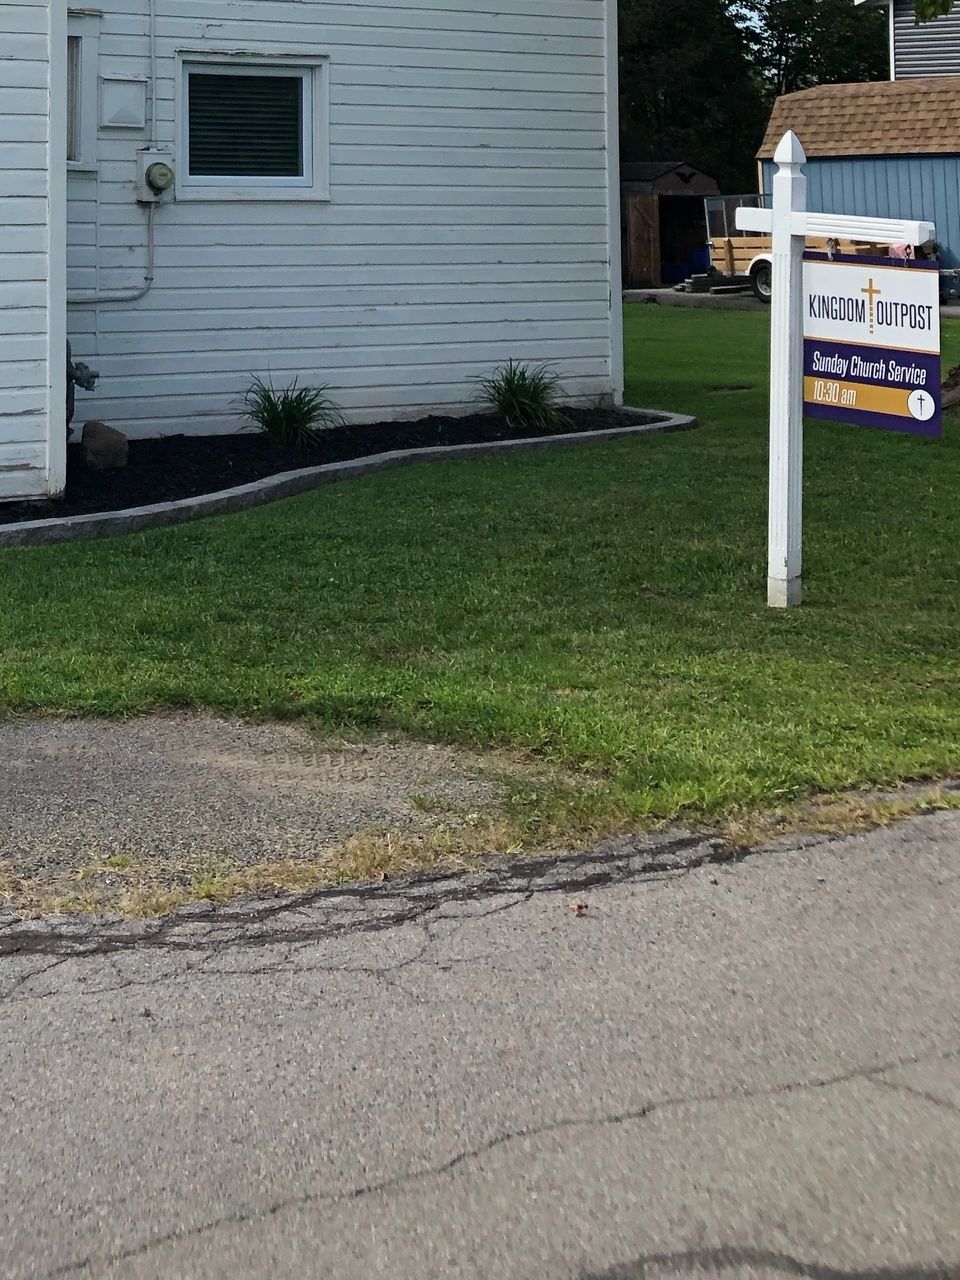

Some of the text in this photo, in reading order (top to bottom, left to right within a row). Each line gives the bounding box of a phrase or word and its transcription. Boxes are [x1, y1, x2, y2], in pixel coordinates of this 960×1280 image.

[809, 294, 933, 330] KINGDOM OUTPOST
[812, 351, 927, 385] Sunday Church Service
[813, 380, 857, 406] 10:30 am
